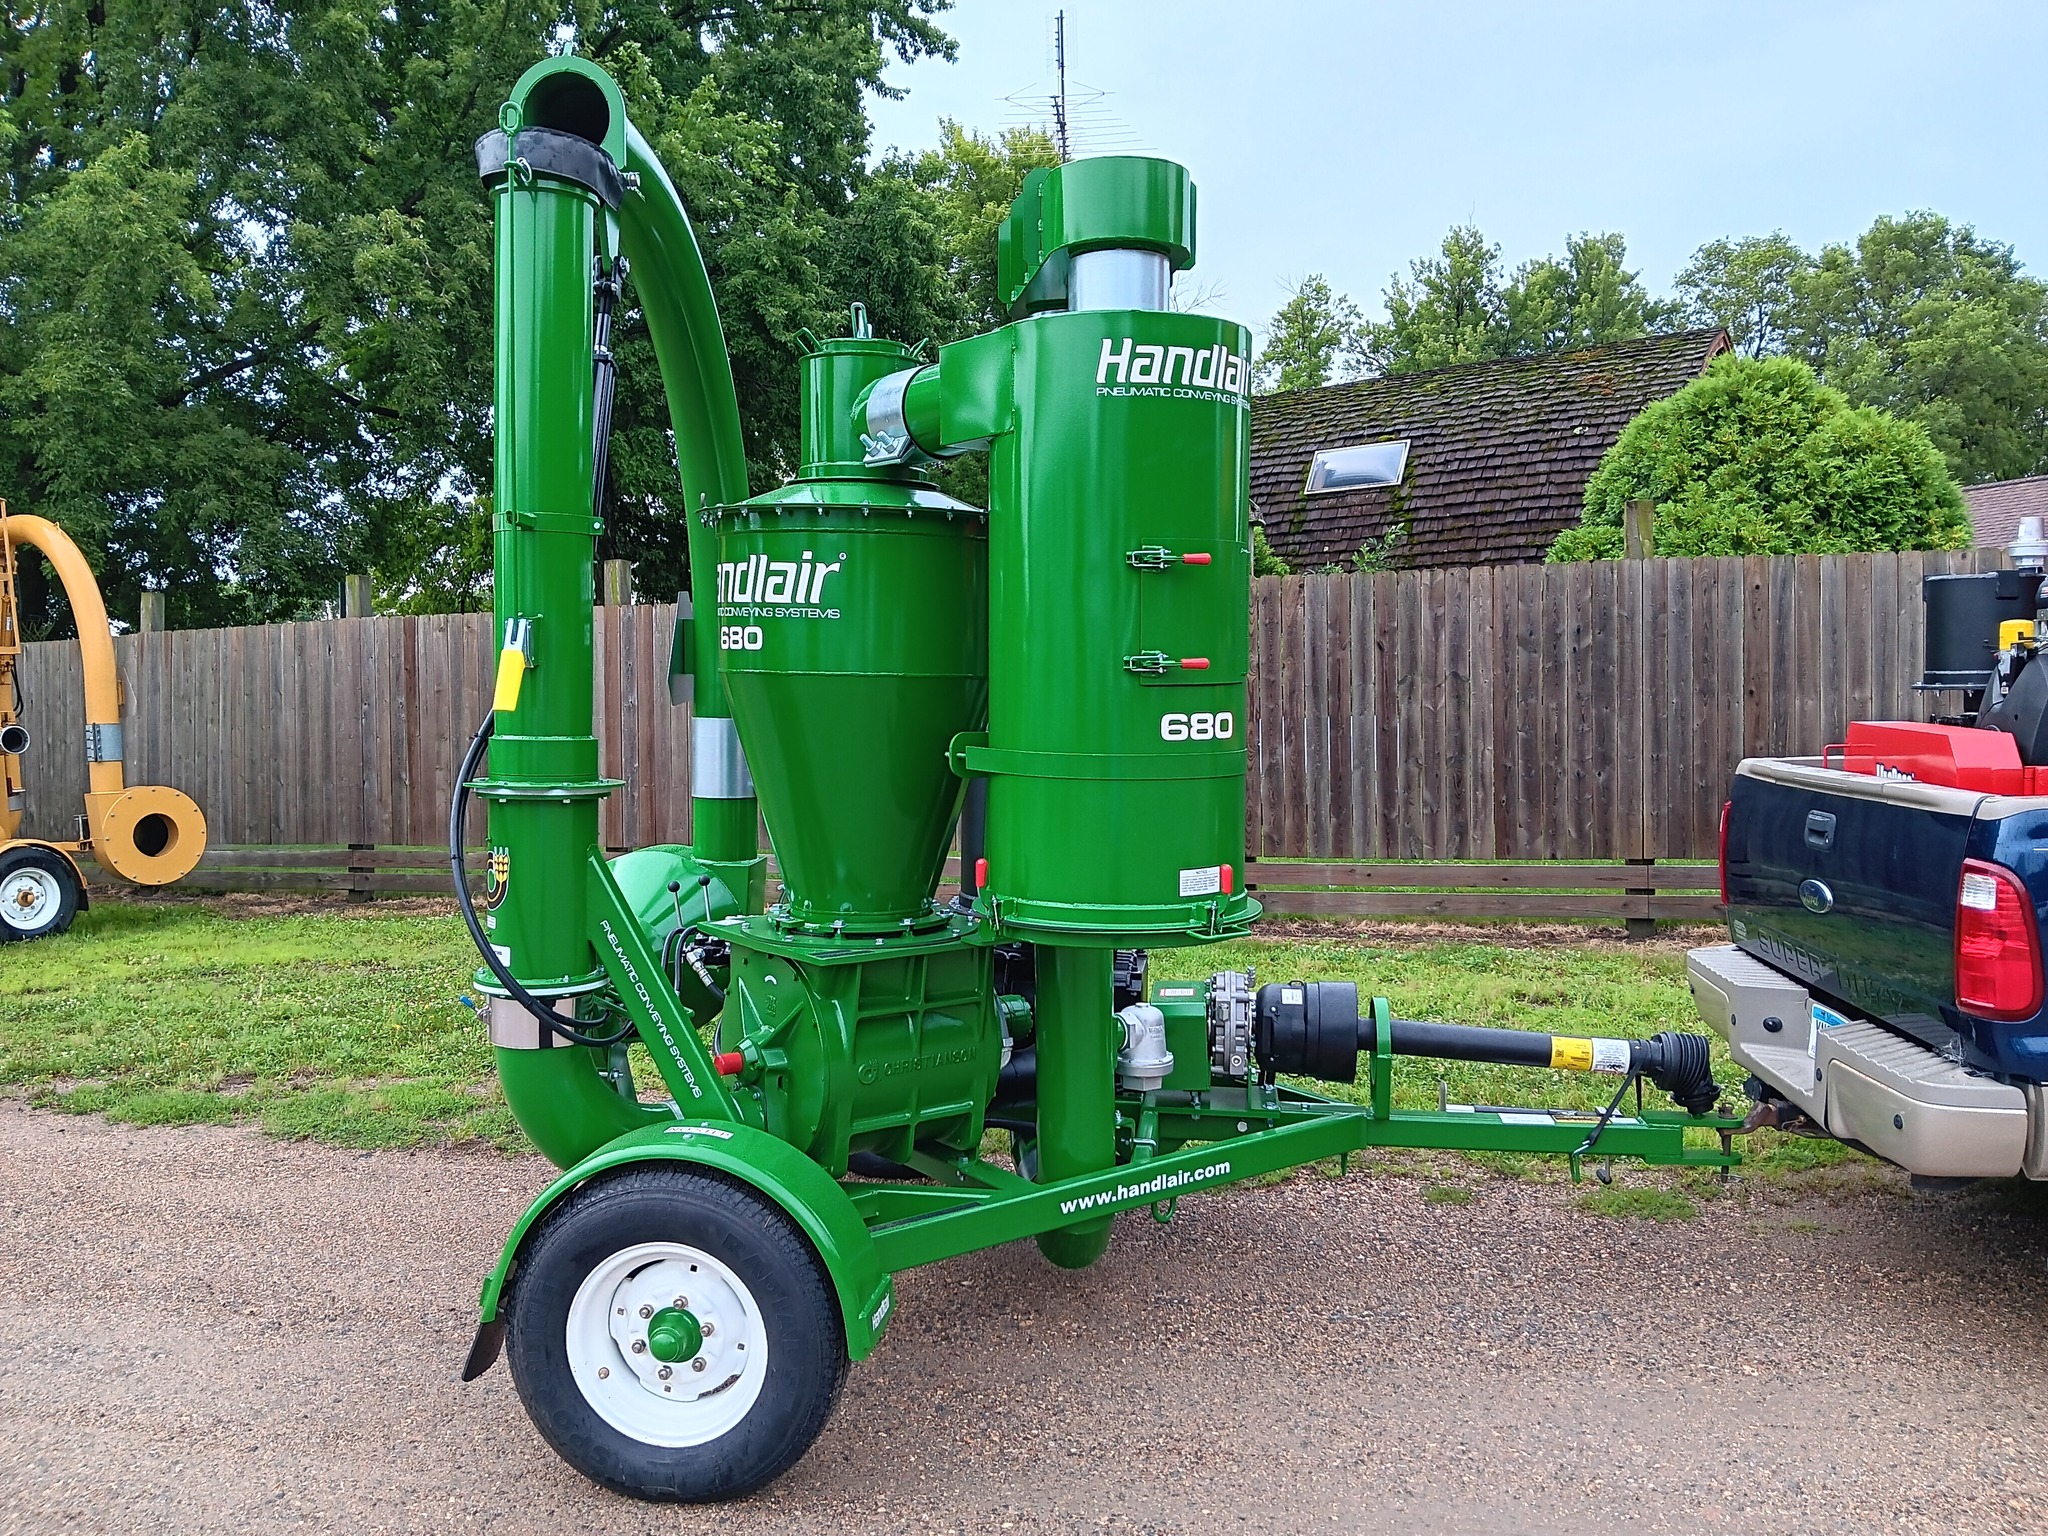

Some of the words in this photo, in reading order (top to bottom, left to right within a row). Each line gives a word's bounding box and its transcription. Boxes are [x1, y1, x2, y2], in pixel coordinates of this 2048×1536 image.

[1096, 387, 1171, 398] PNEUMATIC
[1173, 388, 1230, 404] CONVEYING
[775, 607, 841, 619] SYSTEMS
[720, 626, 763, 650] 680
[1160, 712, 1233, 741] 680
[1757, 929, 1823, 981] SUPER
[600, 920, 639, 984] PNEUMATIC
[634, 981, 674, 1046] CONVEYING
[669, 1043, 702, 1099] SYSTEMS
[1060, 1160, 1231, 1215] www.handlair.com
